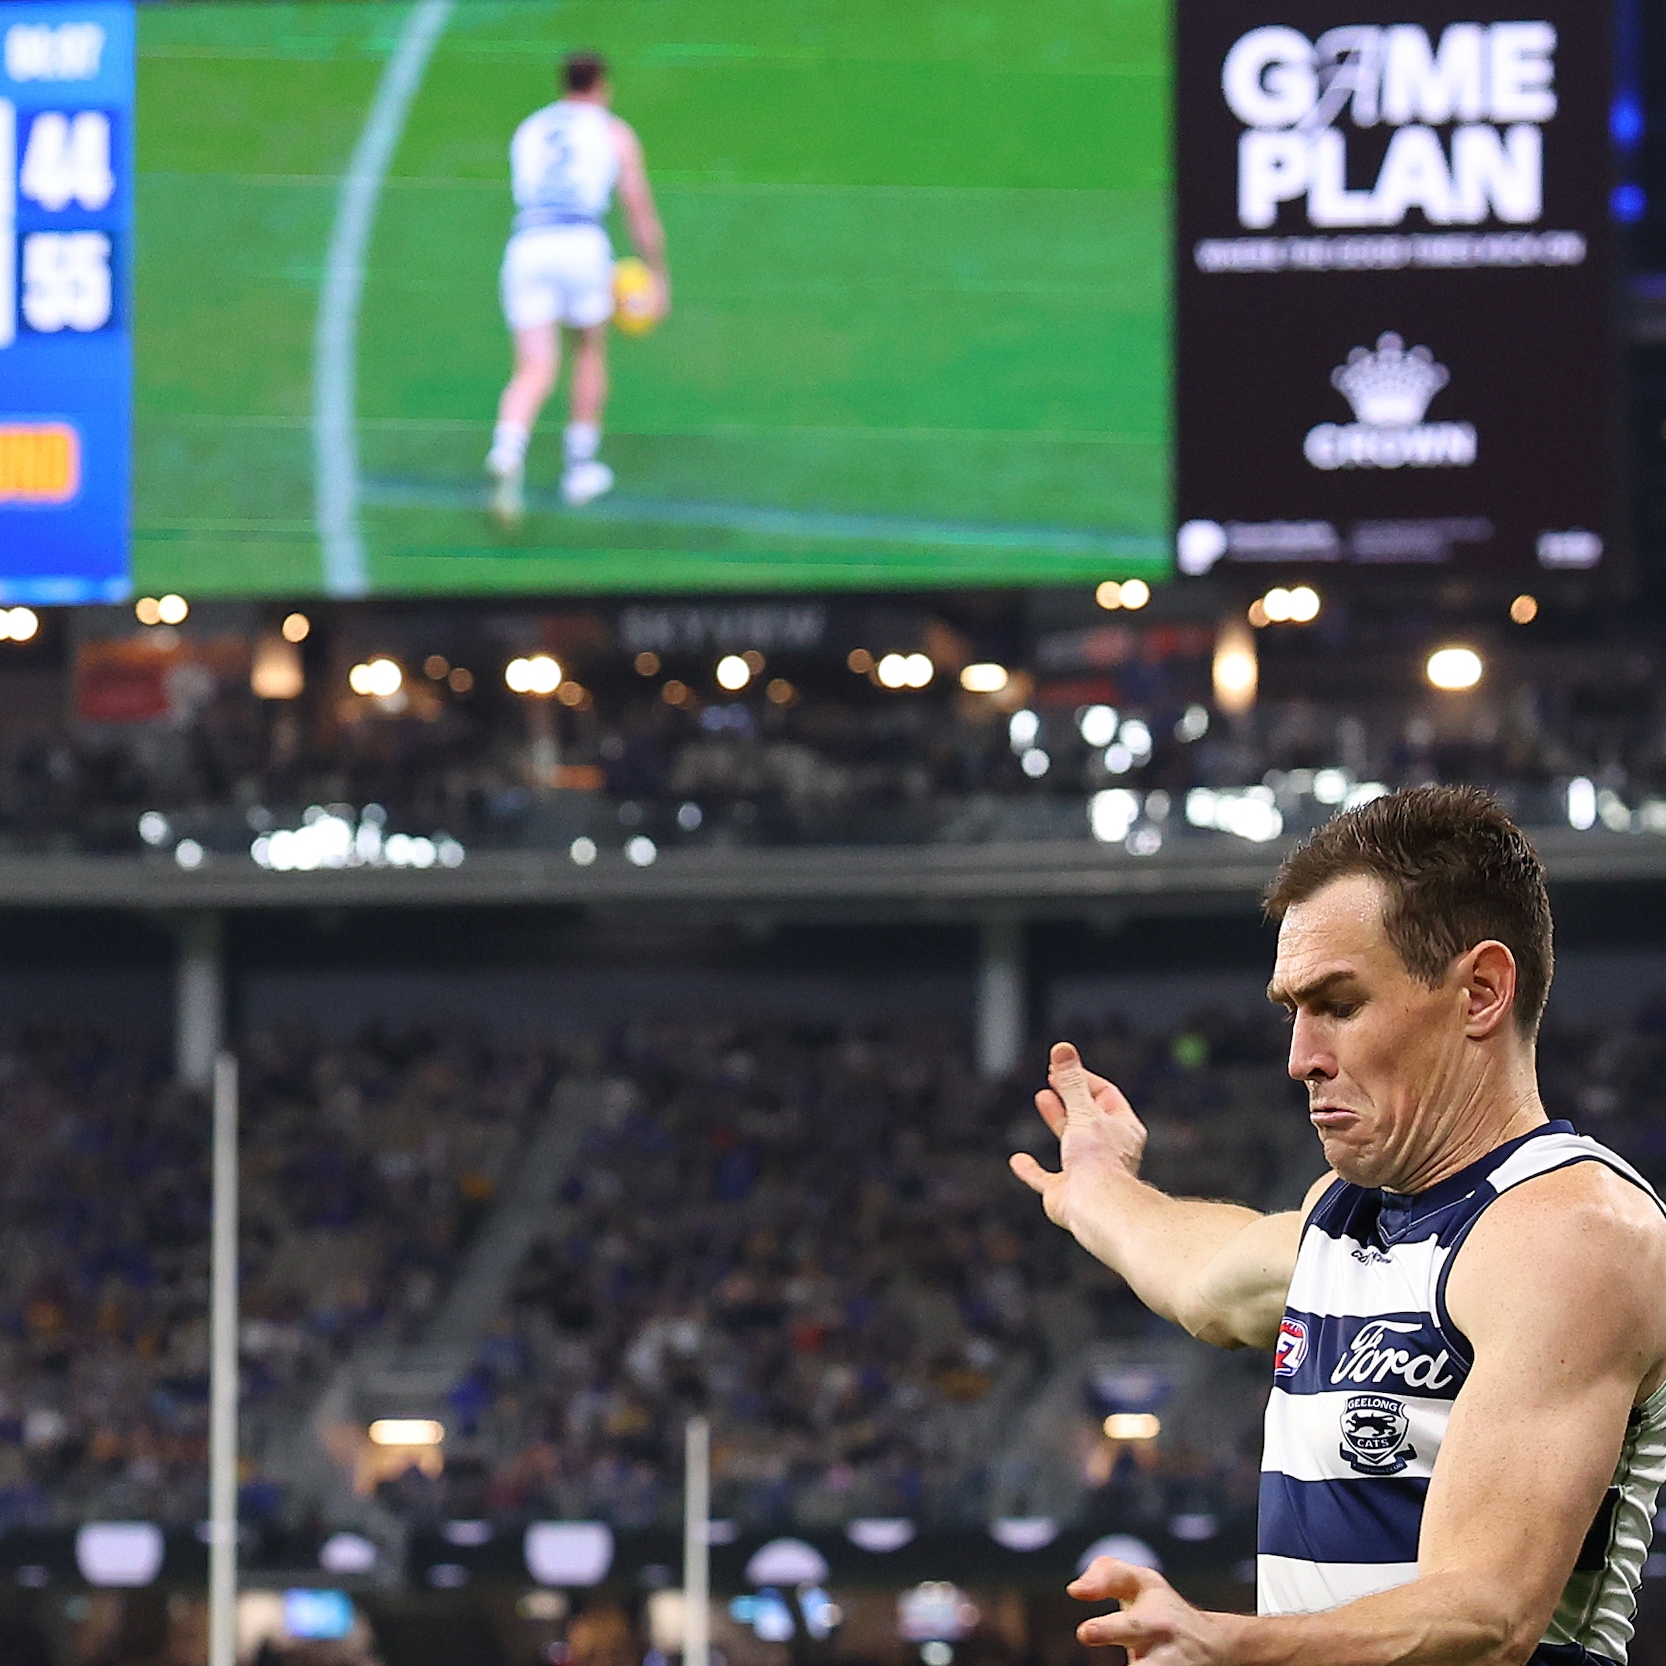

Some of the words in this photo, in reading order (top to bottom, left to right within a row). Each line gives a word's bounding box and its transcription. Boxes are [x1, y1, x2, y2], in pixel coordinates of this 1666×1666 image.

[1222, 21, 1558, 129] GAME
[21, 109, 114, 213] 44
[1238, 122, 1543, 229] PLAN
[1330, 1320, 1453, 1390] Ford
[1348, 1397, 1398, 1412] GEELONG
[1357, 1438, 1389, 1448] CATS
